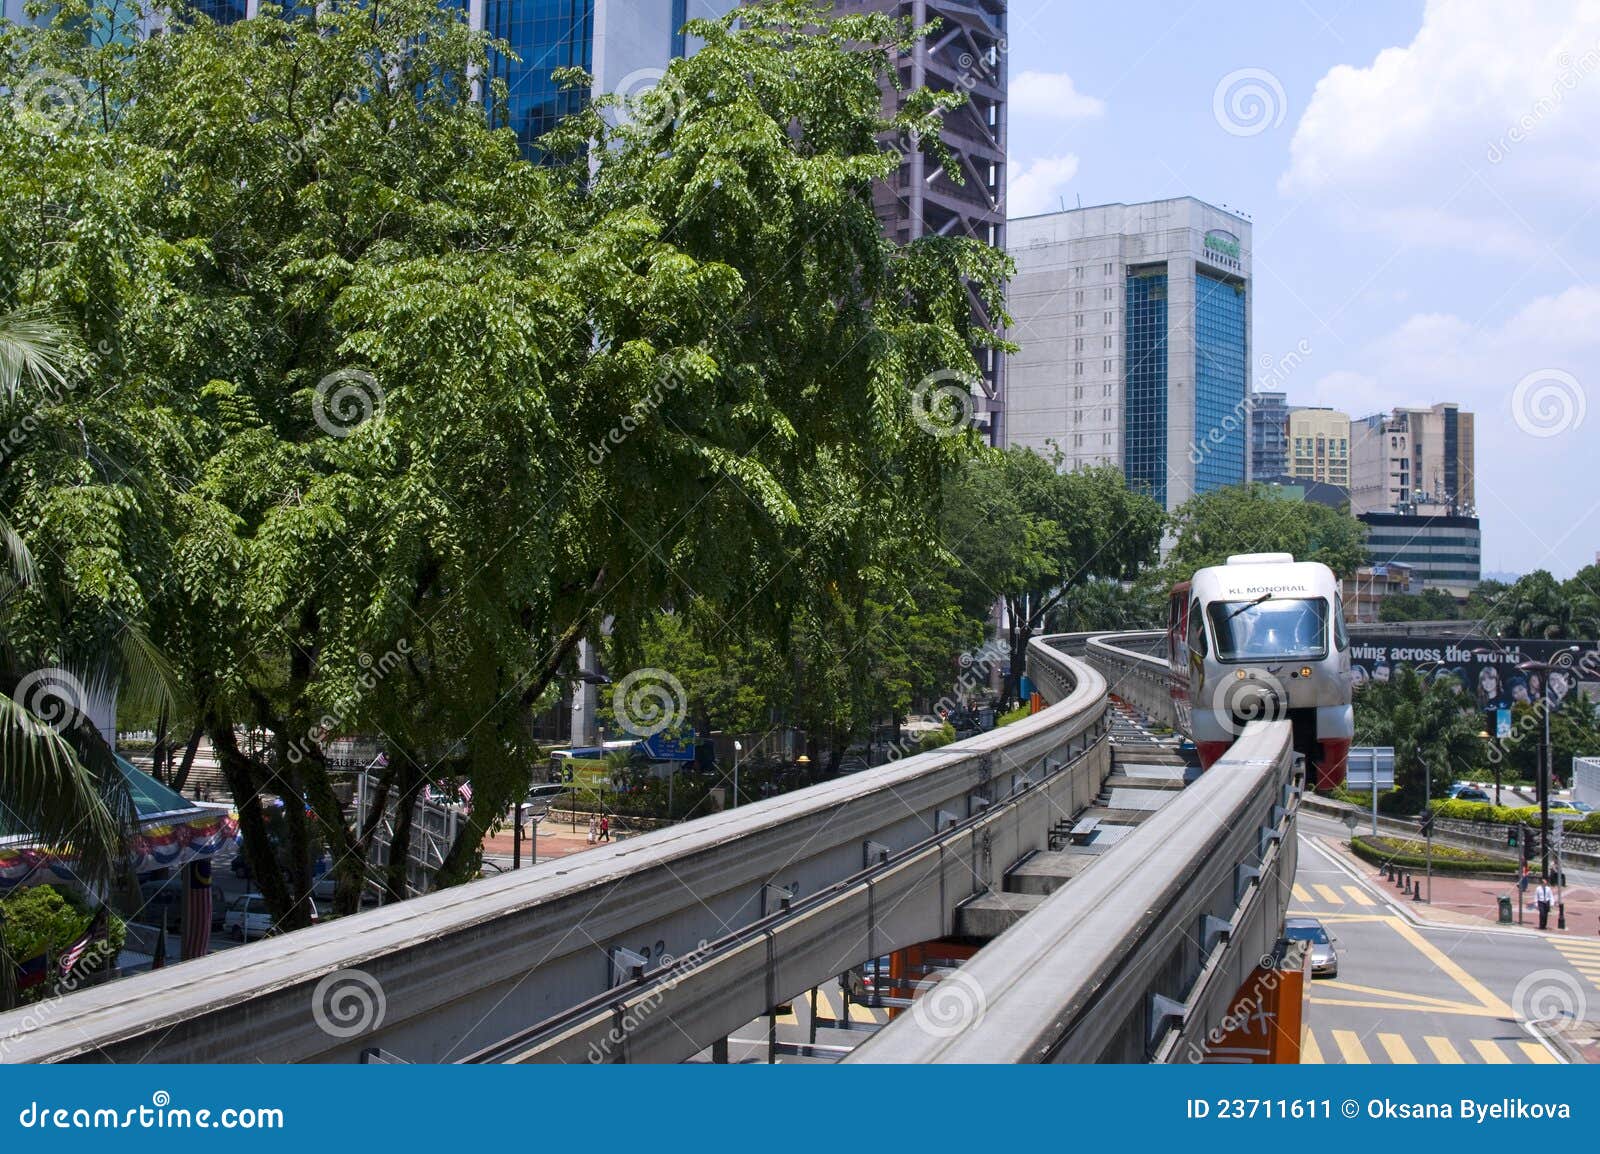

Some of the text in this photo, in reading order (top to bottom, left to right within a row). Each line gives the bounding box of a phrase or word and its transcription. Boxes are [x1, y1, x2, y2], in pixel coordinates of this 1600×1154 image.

[1246, 585, 1309, 593] MONORAIL
[1349, 643, 1387, 662] wing
[1391, 647, 1441, 661] across
[1446, 645, 1472, 662] the
